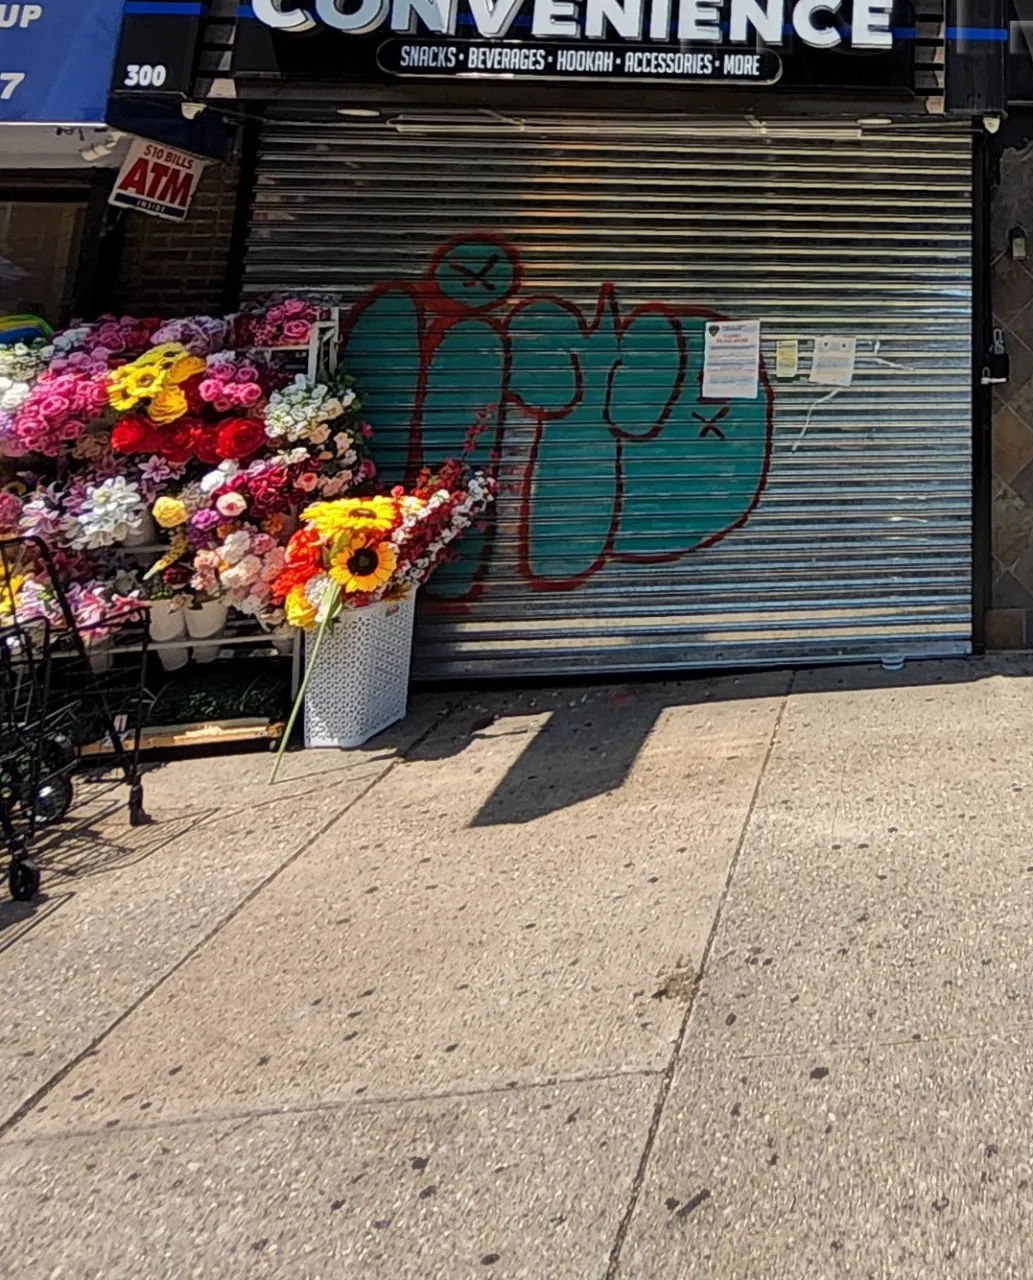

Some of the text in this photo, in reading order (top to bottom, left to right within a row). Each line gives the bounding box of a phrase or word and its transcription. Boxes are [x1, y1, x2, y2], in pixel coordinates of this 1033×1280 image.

[400, 45, 760, 76] SNACKS BEVERAGES HOOKAH ACCESSORIES MORE
[124, 64, 167, 88] 300
[164, 151, 194, 170] BILLS
[117, 156, 195, 208] ATM
[136, 200, 166, 213] INSIDE
